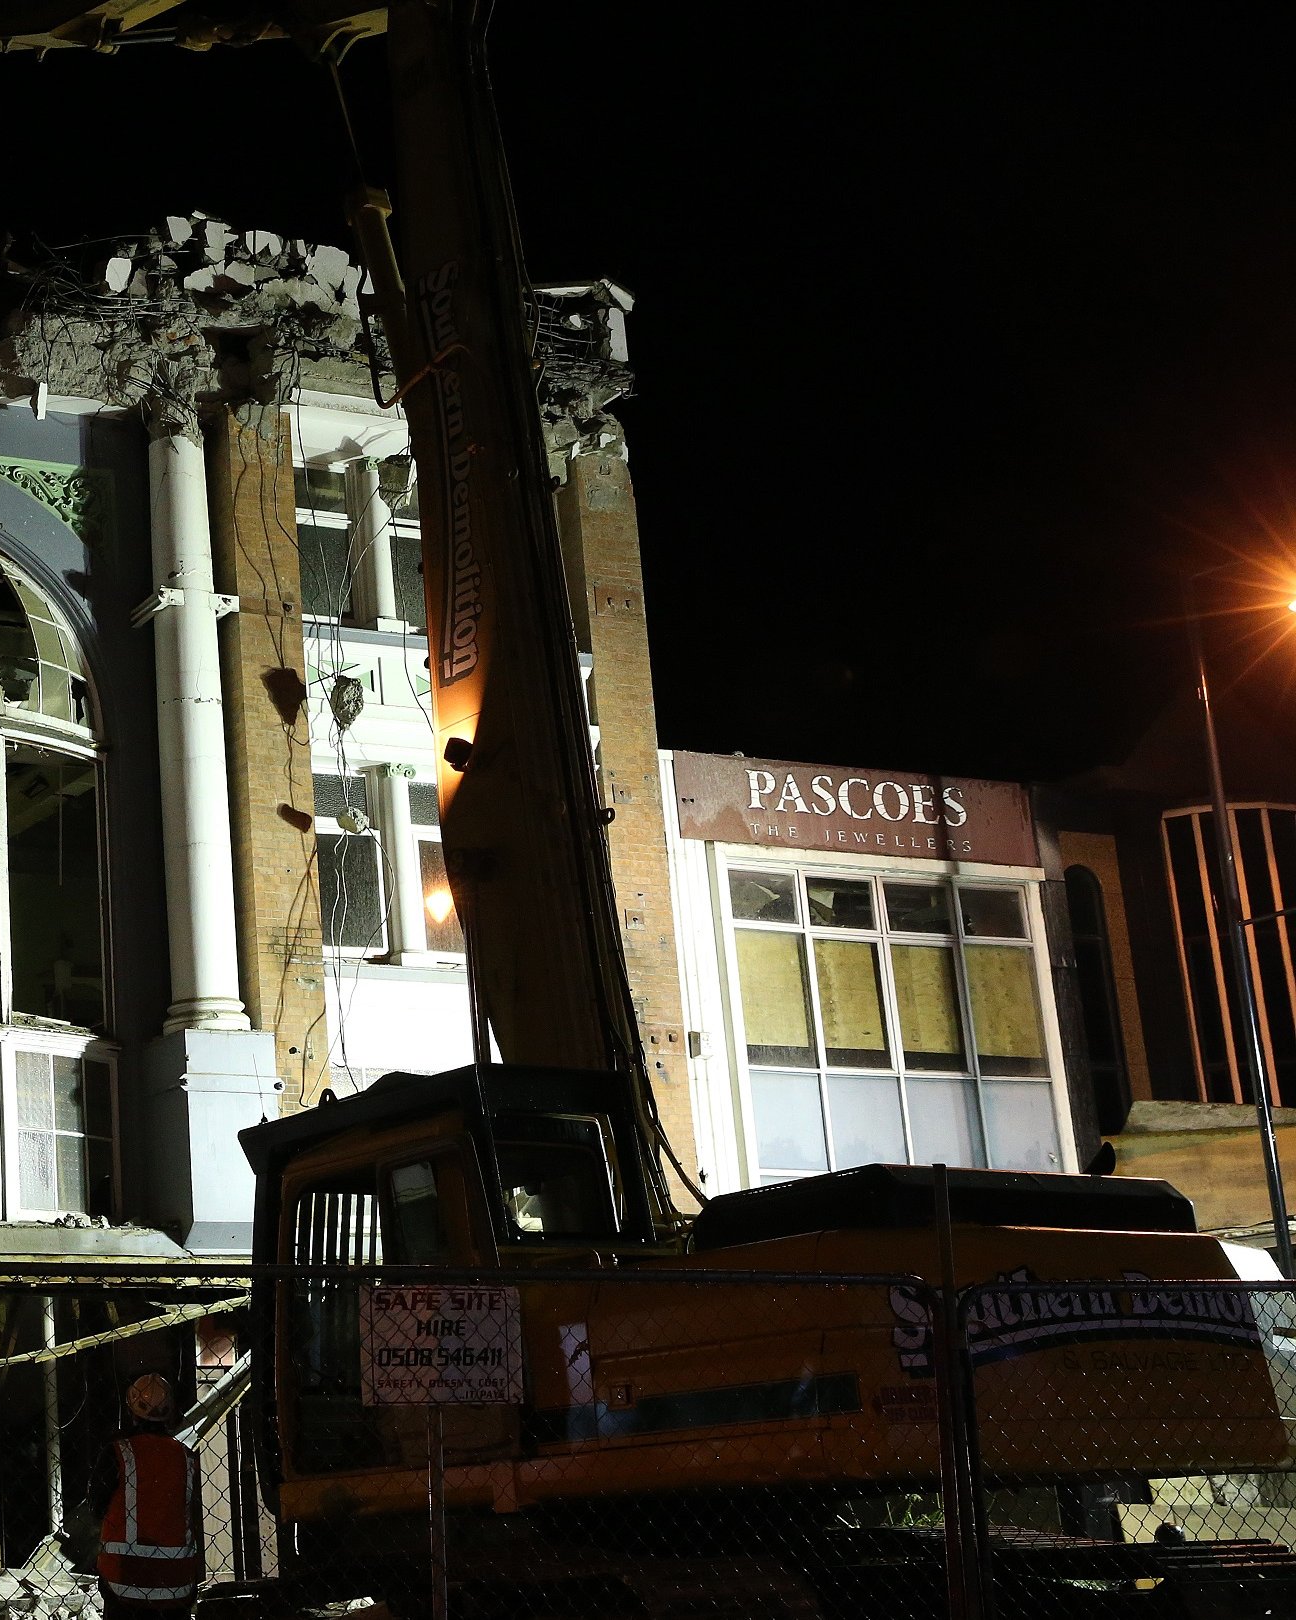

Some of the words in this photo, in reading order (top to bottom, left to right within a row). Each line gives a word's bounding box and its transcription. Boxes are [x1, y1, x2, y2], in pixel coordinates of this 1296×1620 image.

[452, 454, 484, 678] Demolition
[745, 768, 968, 827] PASCOES
[750, 823, 799, 839] THE
[824, 829, 972, 853] JEWELLERS
[375, 1292, 441, 1311] SAFE
[451, 1292, 501, 1311] SITE
[416, 1320, 467, 1336] HIRE
[378, 1347, 434, 1367] 0508
[437, 1347, 474, 1366] 546
[477, 1347, 502, 1366] 411
[377, 1379, 422, 1389] SAFETY
[478, 1378, 505, 1388] COST
